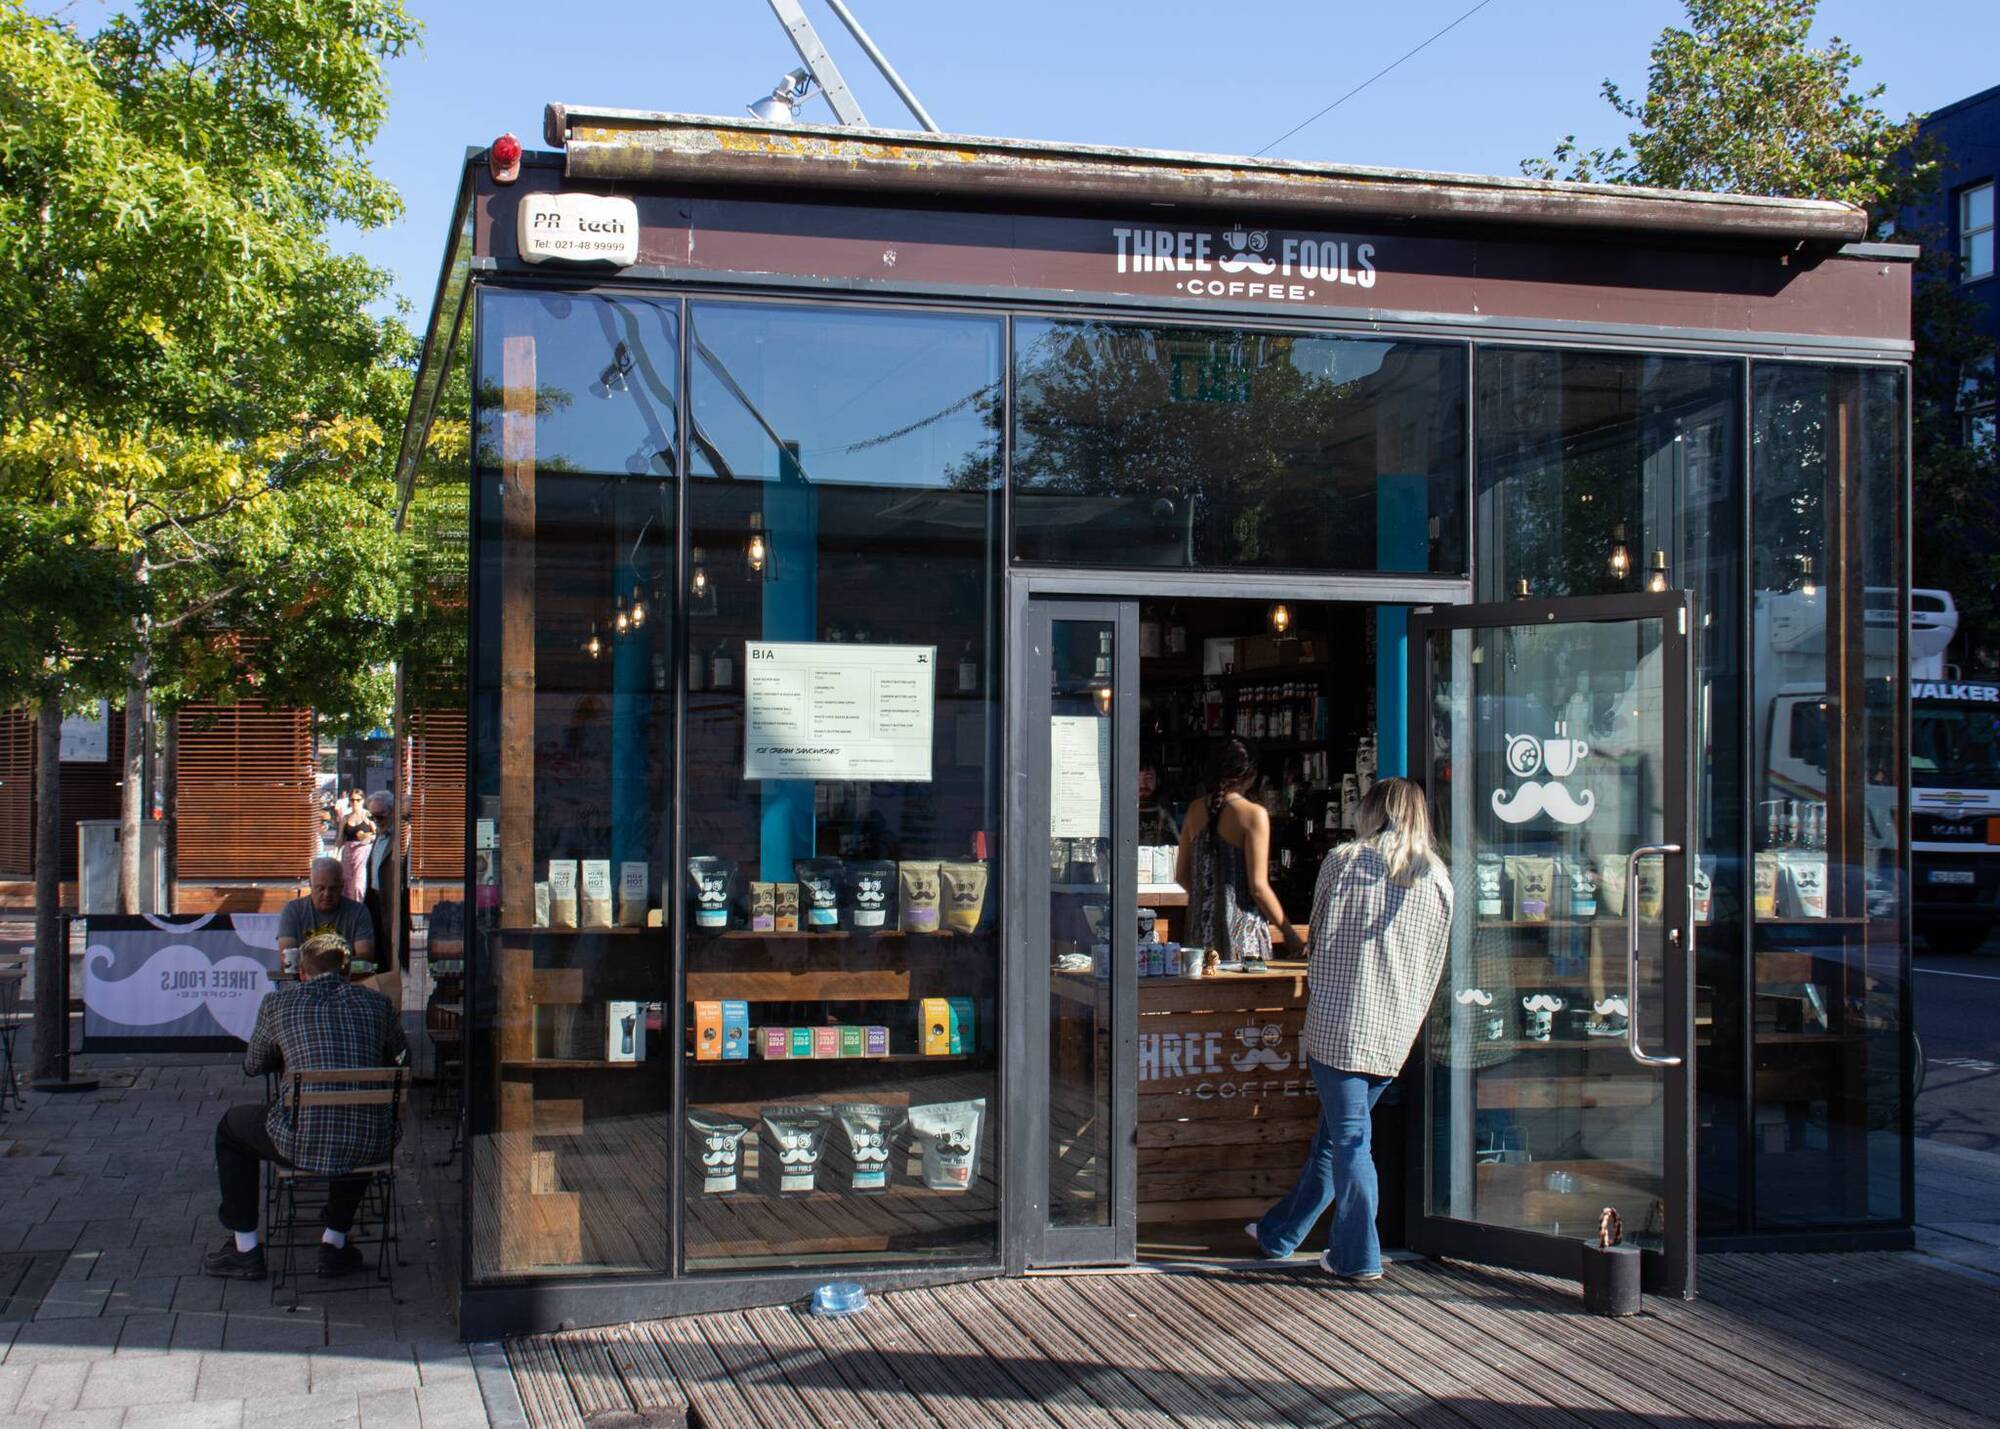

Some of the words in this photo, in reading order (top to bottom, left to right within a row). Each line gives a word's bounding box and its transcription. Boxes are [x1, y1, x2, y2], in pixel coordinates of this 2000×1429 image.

[534, 239, 551, 249] Tel:
[555, 240, 591, 250] 021-48
[1113, 228, 1212, 273] THREE
[1282, 238, 1377, 288] FOOLS
[752, 650, 775, 659] BIA
[1138, 1031, 1224, 1081] HREE
